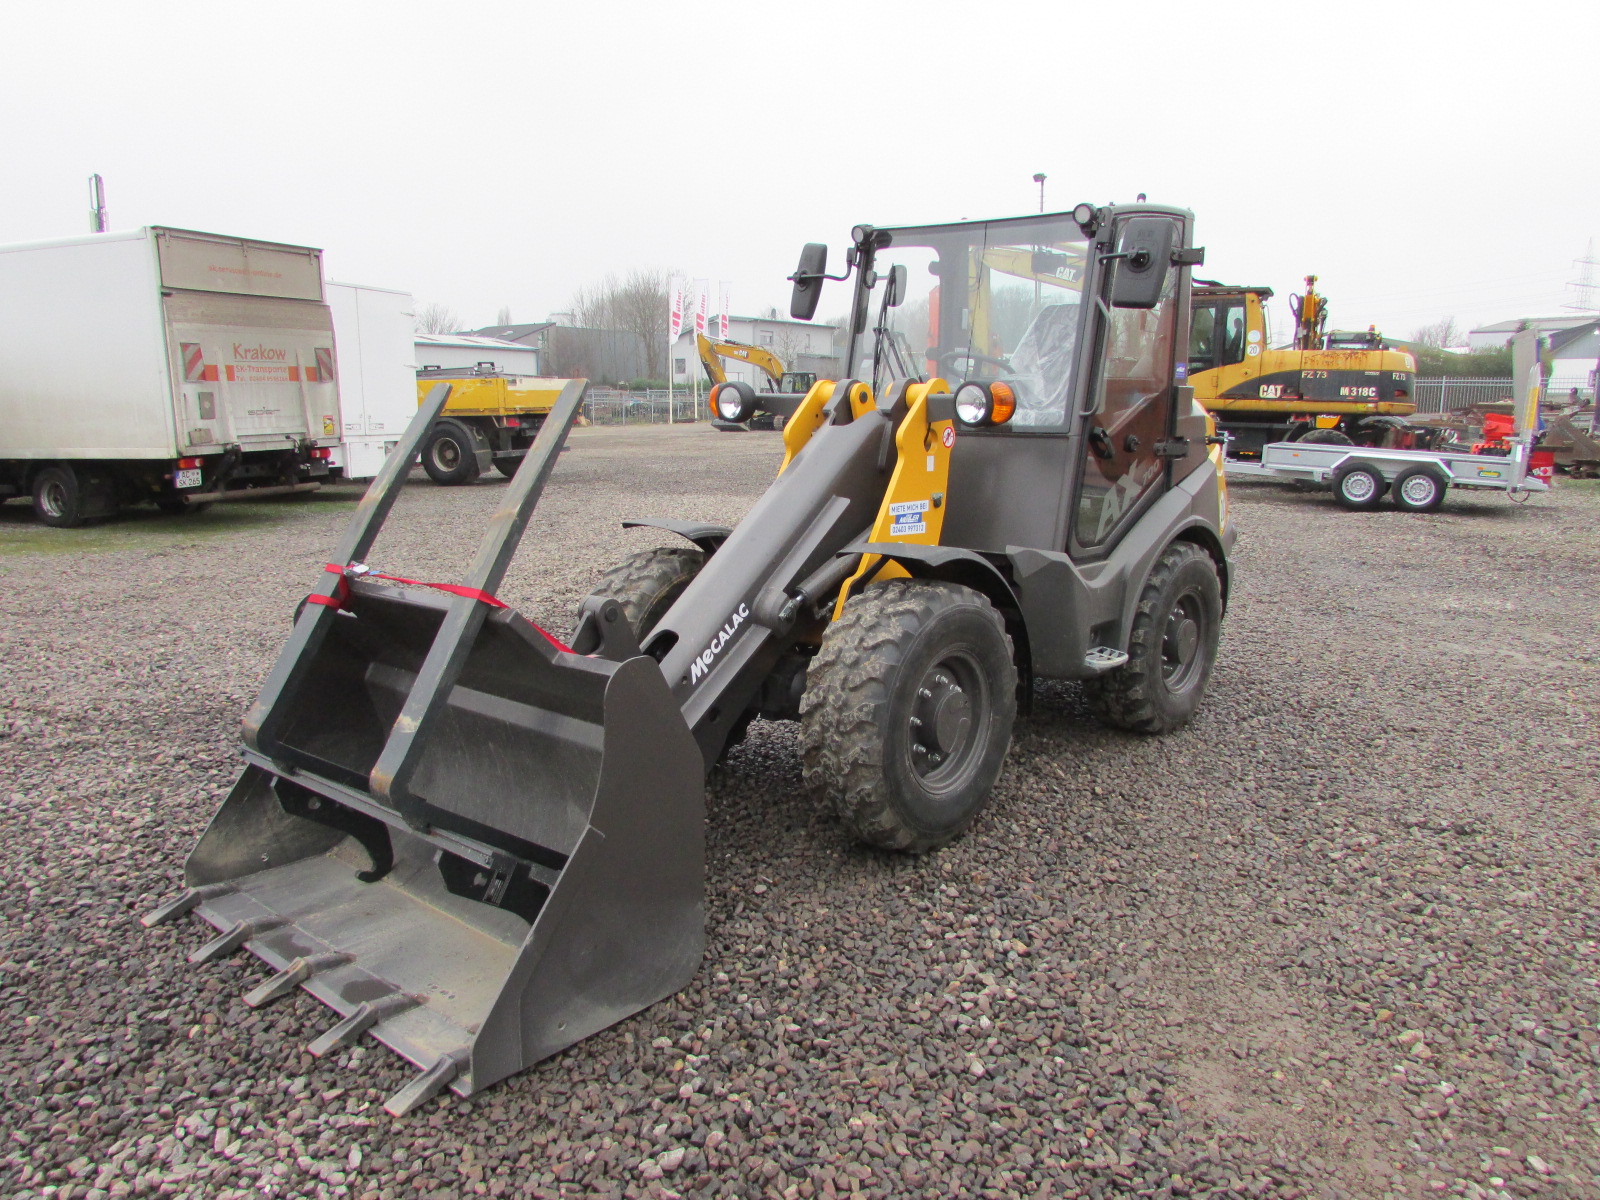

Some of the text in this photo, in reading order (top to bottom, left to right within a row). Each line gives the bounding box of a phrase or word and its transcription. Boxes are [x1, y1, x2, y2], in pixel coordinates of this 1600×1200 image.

[1056, 267, 1076, 281] CAT
[233, 343, 286, 360] Krakow
[1249, 346, 1258, 354] 20
[236, 365, 287, 374] SK-Transporte
[1301, 371, 1327, 379] FZ 73
[1392, 372, 1400, 380] FZ
[1259, 384, 1283, 398] CAT
[1340, 387, 1376, 397] M 318C
[1143, 459, 1160, 487] 700
[891, 502, 928, 513] MIETE MICH BEI
